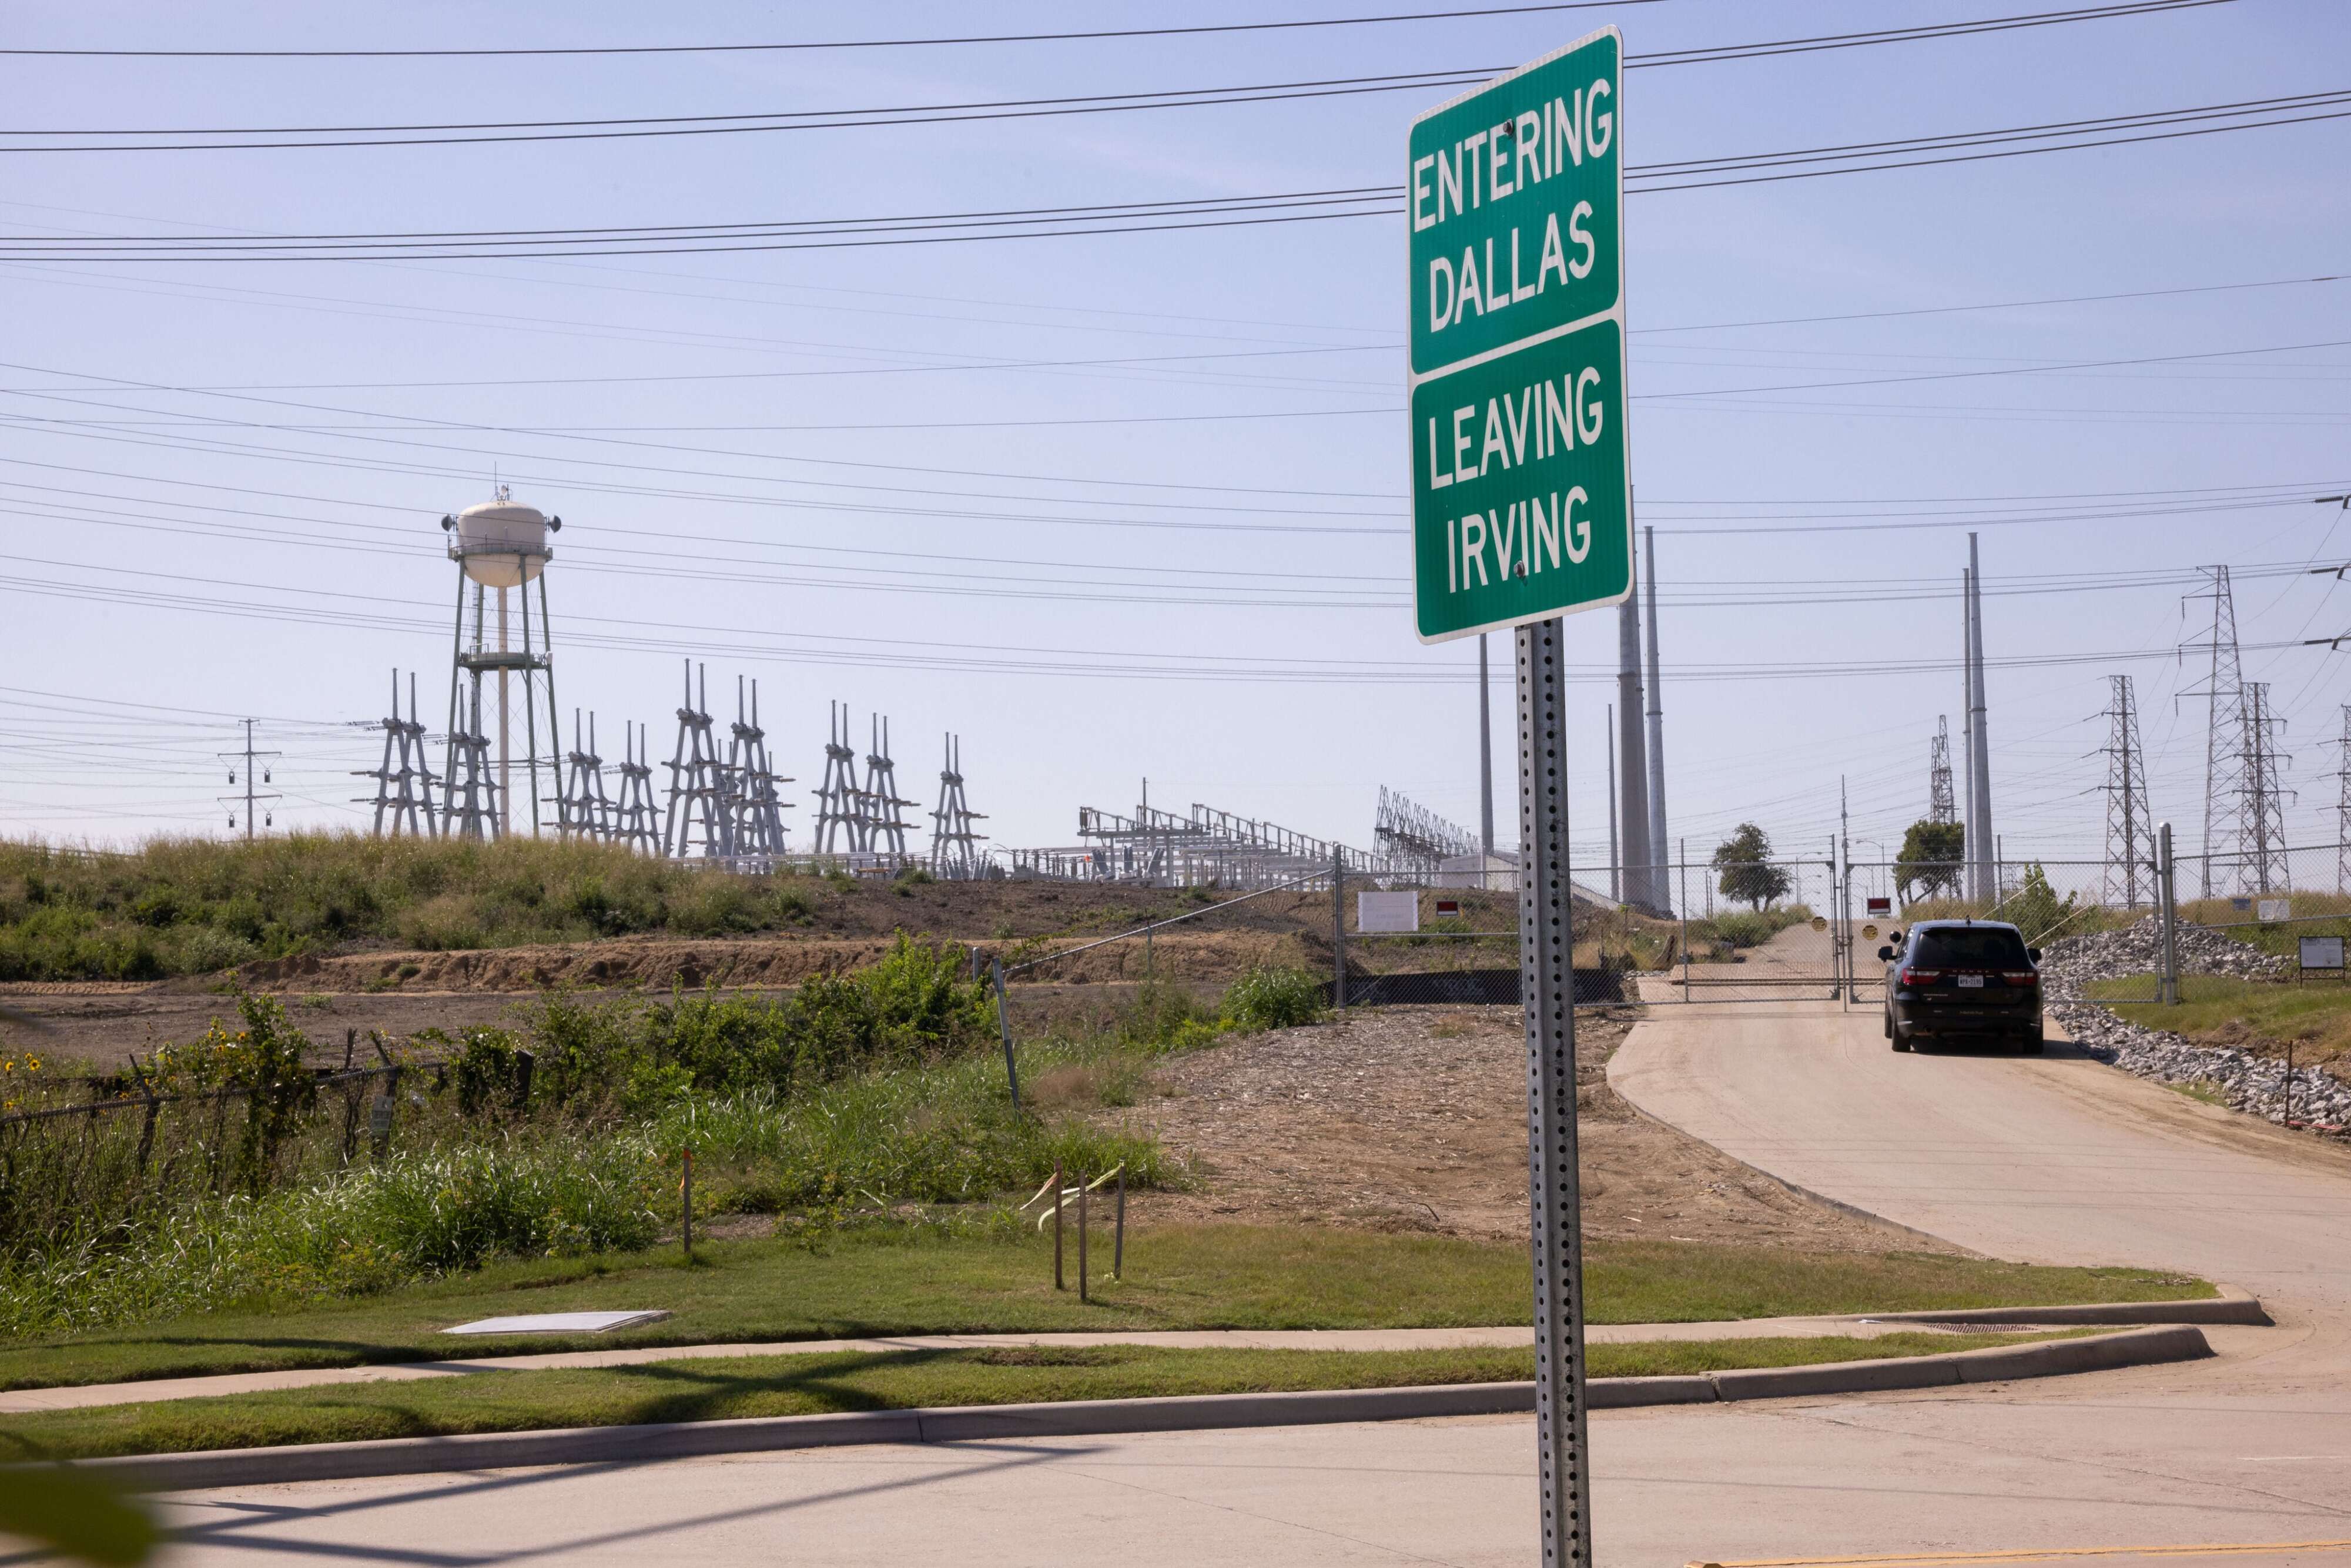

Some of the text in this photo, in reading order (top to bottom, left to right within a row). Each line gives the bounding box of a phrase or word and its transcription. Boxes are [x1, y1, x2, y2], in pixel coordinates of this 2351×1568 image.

[1414, 78, 1612, 233] ENTERING
[1430, 200, 1595, 333] DALLAS
[1429, 366, 1603, 490] LEAVING
[1448, 485, 1591, 593] IRVING
